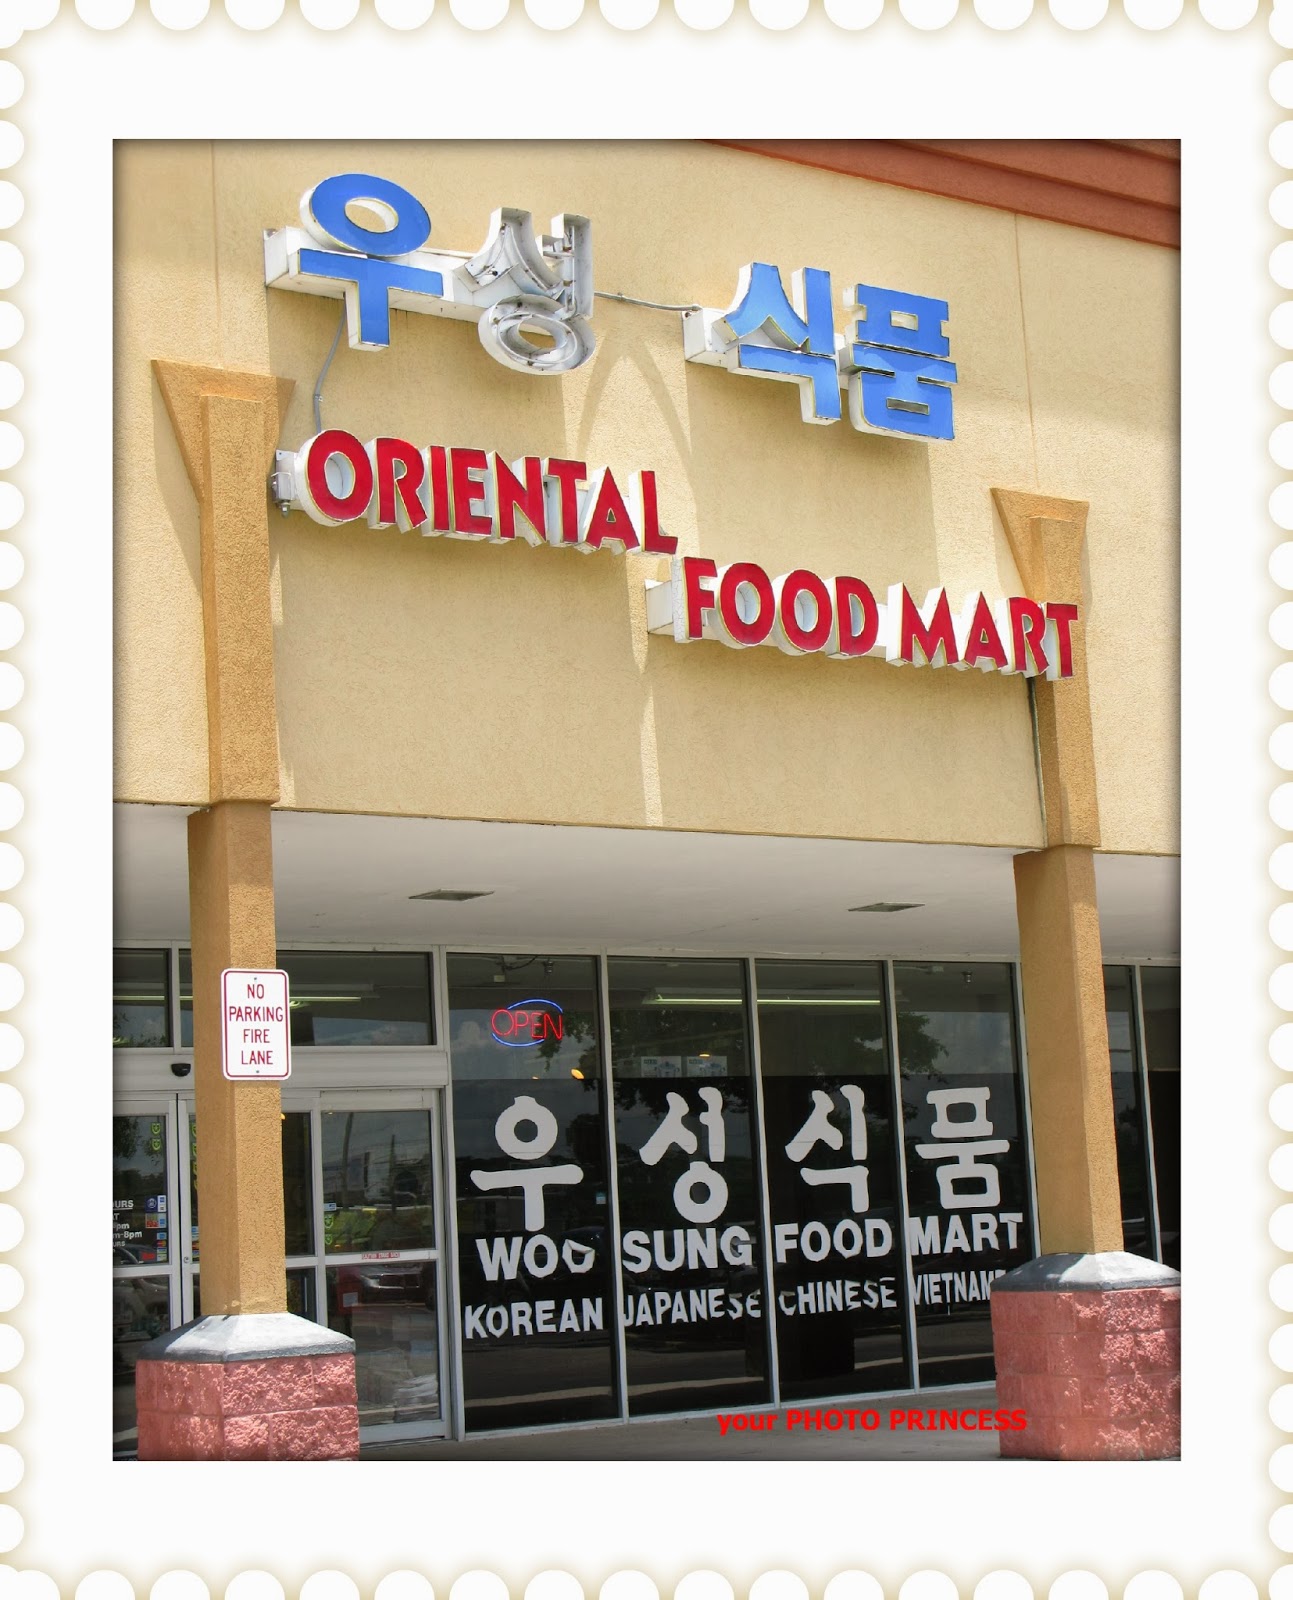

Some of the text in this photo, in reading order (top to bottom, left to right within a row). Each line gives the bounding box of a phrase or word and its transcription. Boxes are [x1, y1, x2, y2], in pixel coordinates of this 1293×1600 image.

[304, 429, 678, 554] ORIENTAL
[681, 557, 1079, 679] FOOD MART
[247, 984, 265, 999] NO
[229, 1006, 284, 1022] PARKING
[491, 1008, 564, 1040] OPEN
[243, 1029, 270, 1043] FIRE
[241, 1051, 273, 1065] LANE
[475, 1212, 1024, 1282] WOO SUNG FOOD MART
[465, 1297, 604, 1340] KOREAN
[622, 1288, 762, 1328] JAPANESE
[778, 1277, 898, 1316] CHINESE
